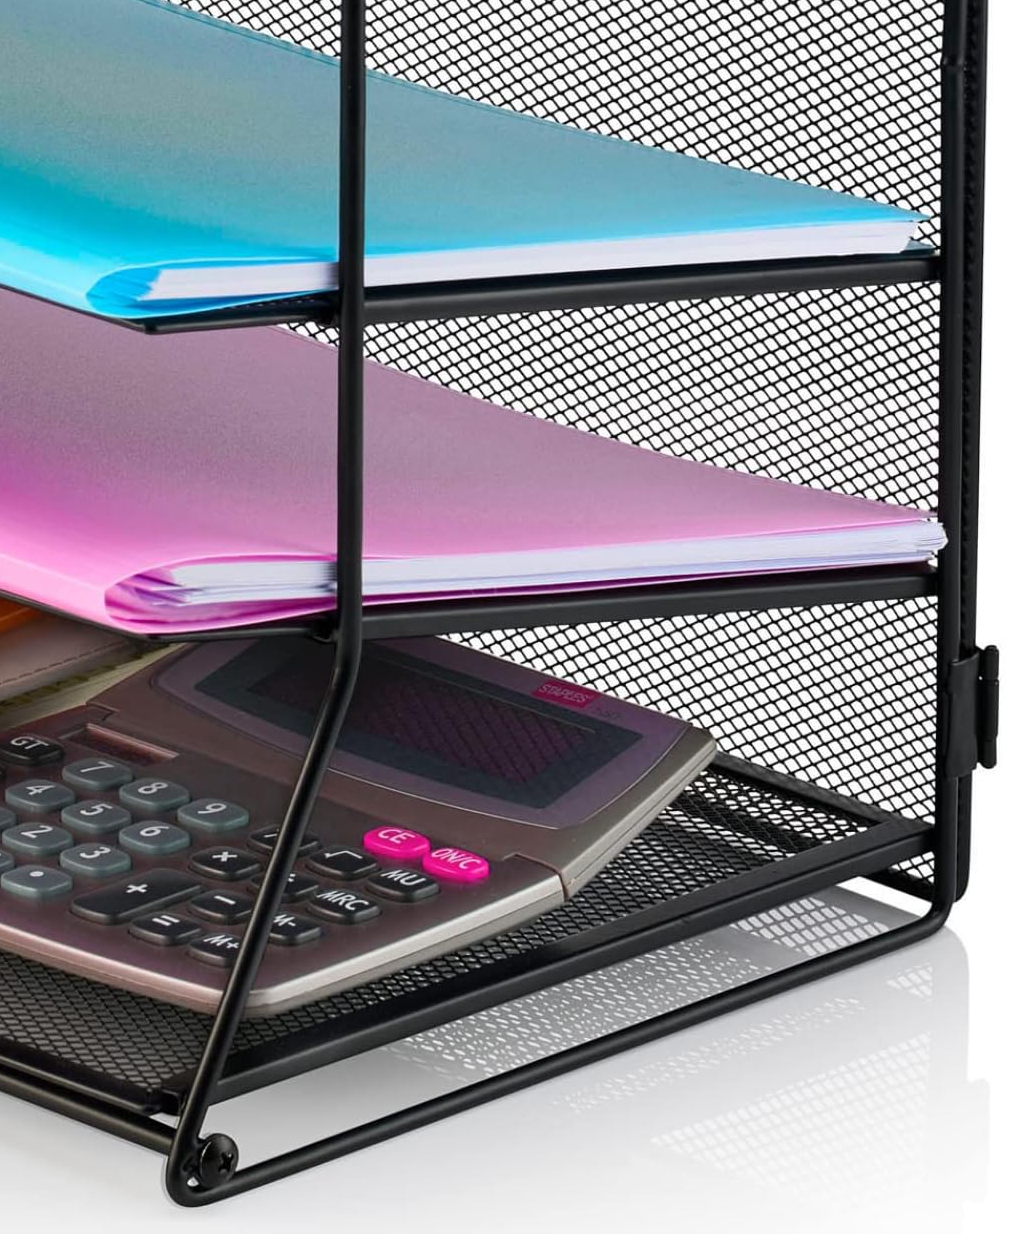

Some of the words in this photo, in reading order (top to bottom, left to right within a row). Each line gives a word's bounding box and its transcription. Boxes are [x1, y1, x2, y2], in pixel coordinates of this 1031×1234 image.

[10, 736, 49, 750] GT
[80, 761, 114, 773] 7
[138, 782, 168, 794] 8
[197, 802, 227, 815] 9
[25, 784, 55, 796] 4
[79, 803, 113, 816] 5
[139, 825, 170, 837] 6
[20, 825, 53, 839] 2
[79, 846, 111, 859] 3
[377, 827, 415, 844] CE
[431, 847, 481, 870] ON/C
[381, 869, 426, 886] MU
[317, 890, 369, 911] MRC
